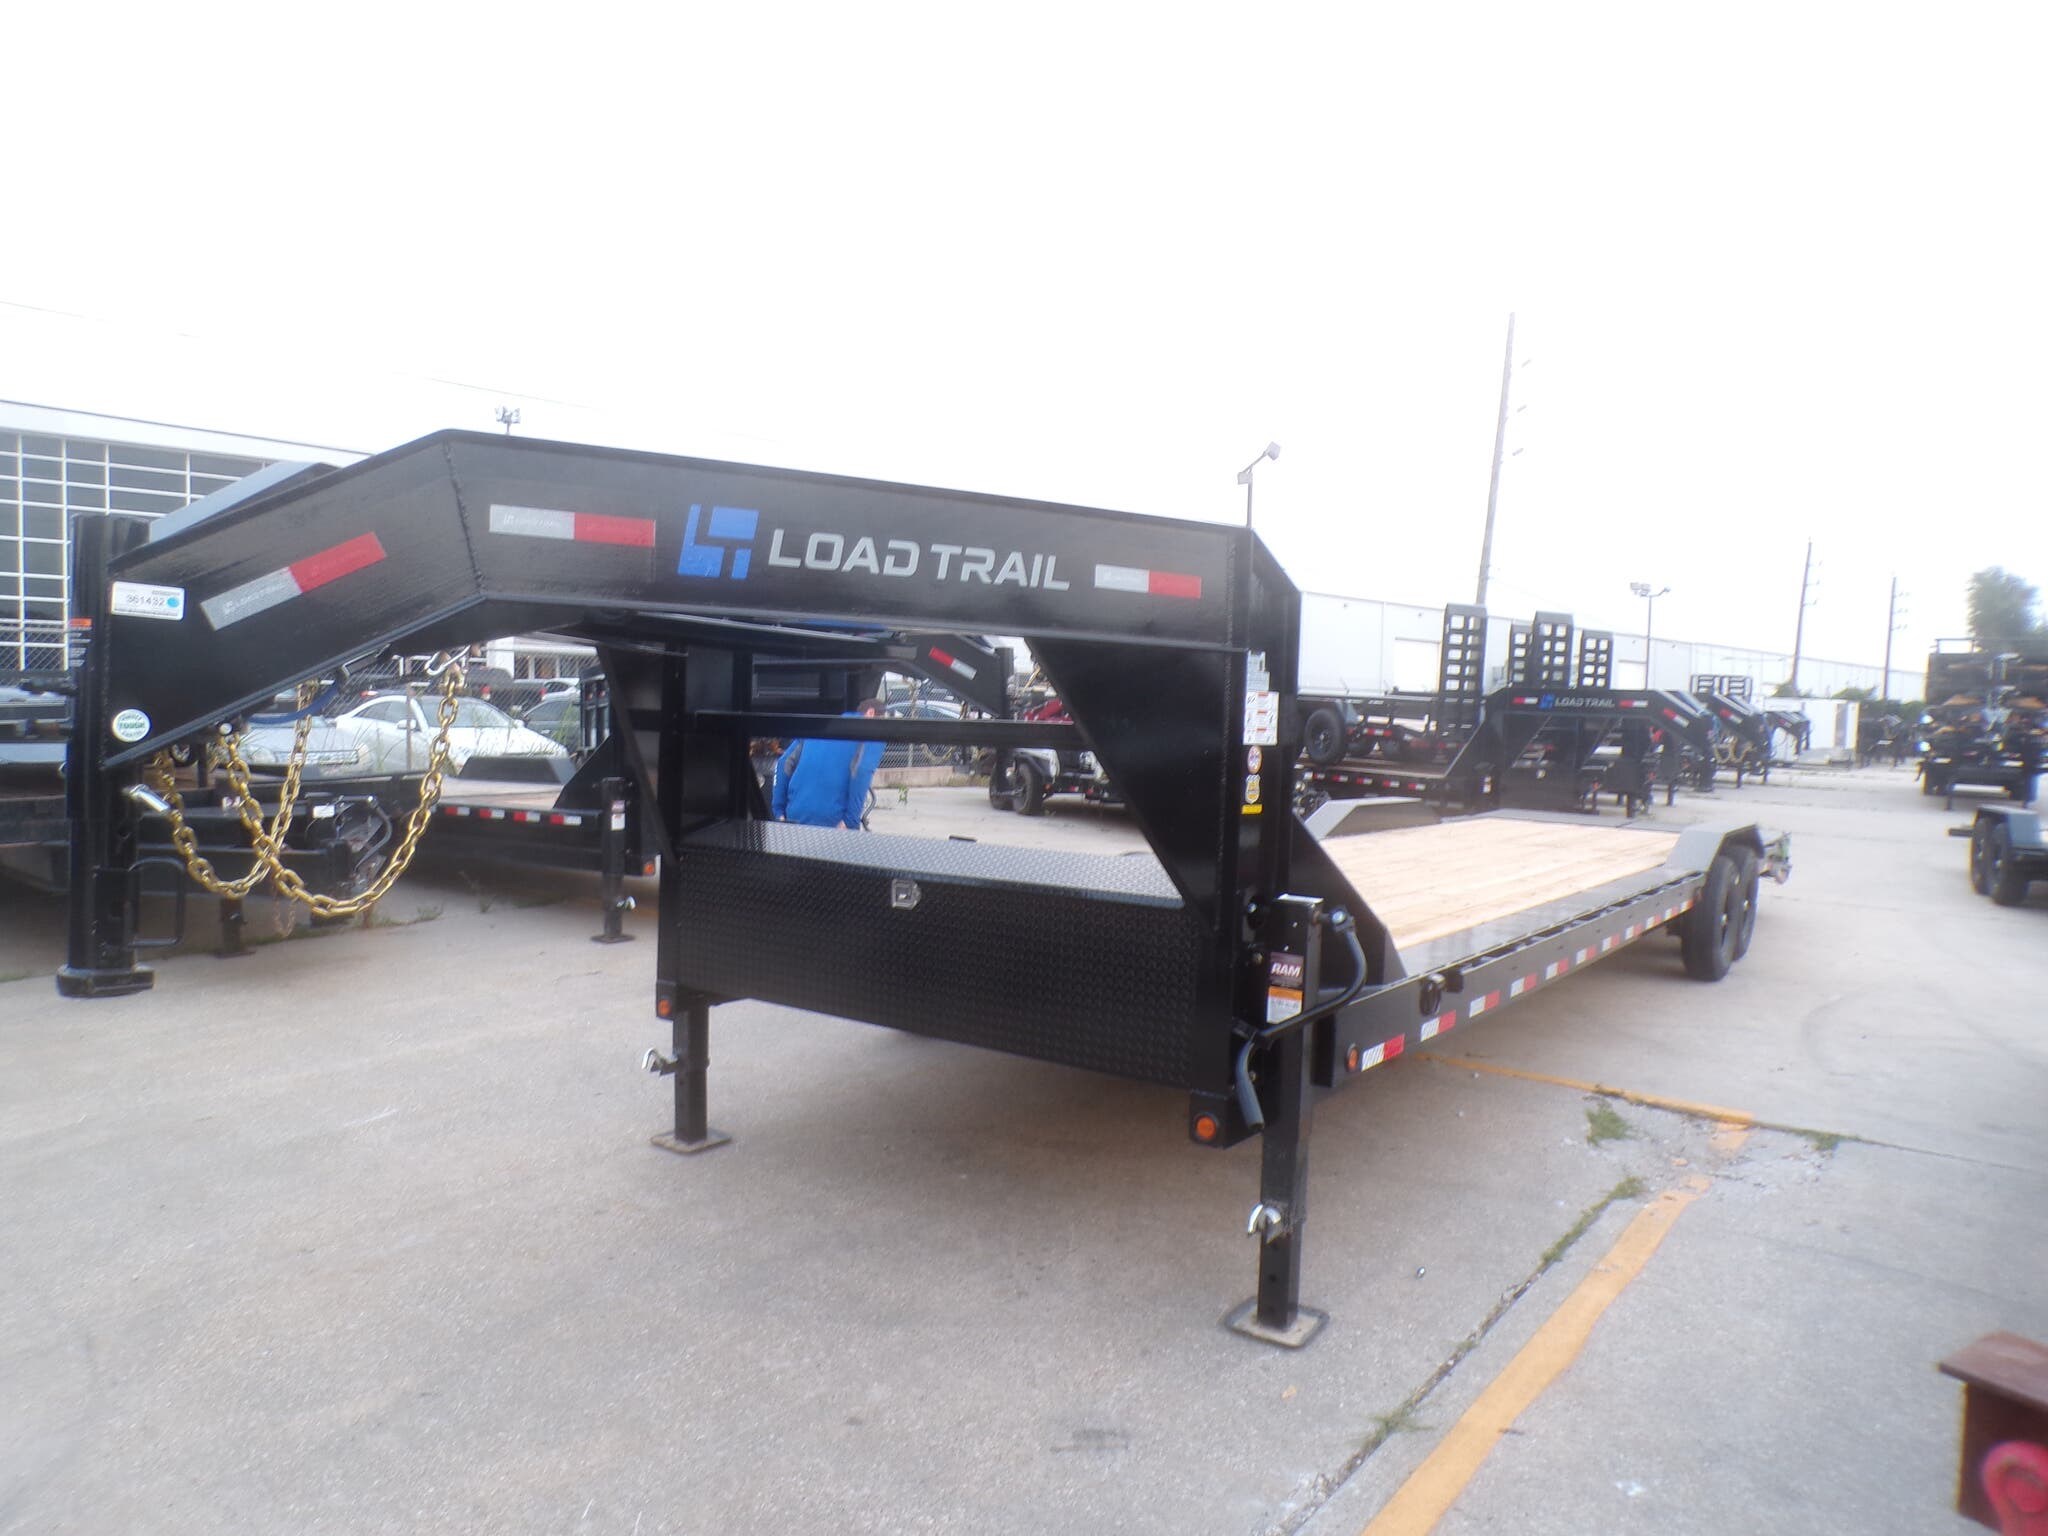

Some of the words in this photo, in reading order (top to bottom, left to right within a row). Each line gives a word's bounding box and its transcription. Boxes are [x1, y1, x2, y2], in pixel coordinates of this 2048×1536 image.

[768, 528, 920, 577] LOAD
[931, 543, 1071, 592] TRAIL
[1554, 696, 1584, 708] LOAD
[1585, 698, 1615, 708] TRAIL
[1270, 962, 1302, 977] RAM
